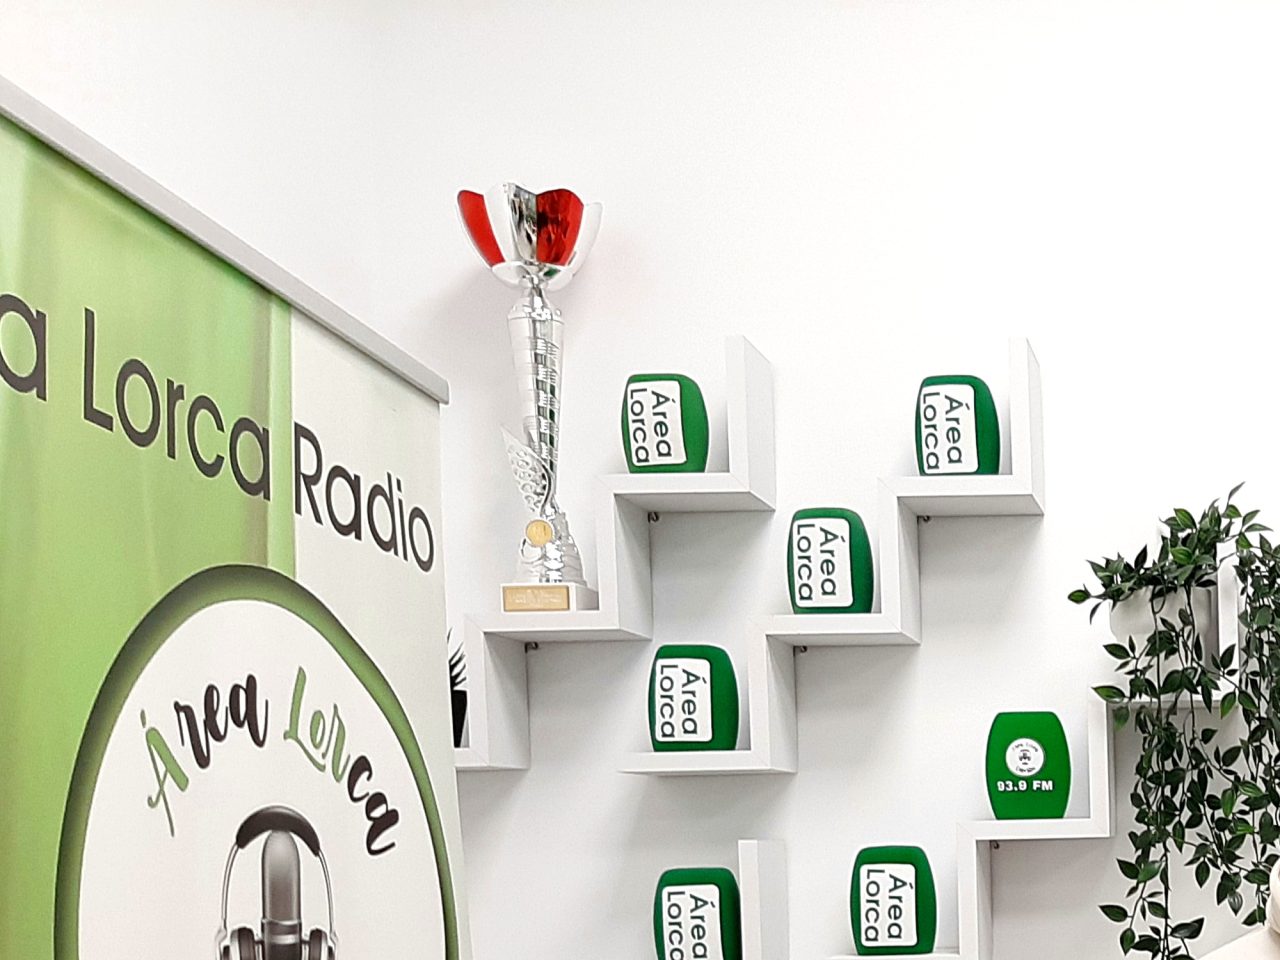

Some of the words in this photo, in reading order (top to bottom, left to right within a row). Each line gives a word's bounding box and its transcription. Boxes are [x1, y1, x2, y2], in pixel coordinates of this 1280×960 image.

[83, 307, 271, 501] Lorca
[293, 421, 434, 572] Radio
[630, 388, 650, 463] Lorca
[651, 390, 676, 457] Área
[923, 392, 940, 470] Lorca
[944, 394, 970, 464] Área
[797, 524, 815, 601] Lorca
[819, 526, 846, 596] Área
[660, 664, 679, 738] Lorca
[681, 668, 707, 735] Área
[140, 673, 269, 836] Área
[283, 665, 400, 857] Lorca
[1032, 780, 1053, 791] FM
[689, 893, 716, 959] Área
[864, 869, 885, 942] Lorca
[887, 873, 913, 939] Área
